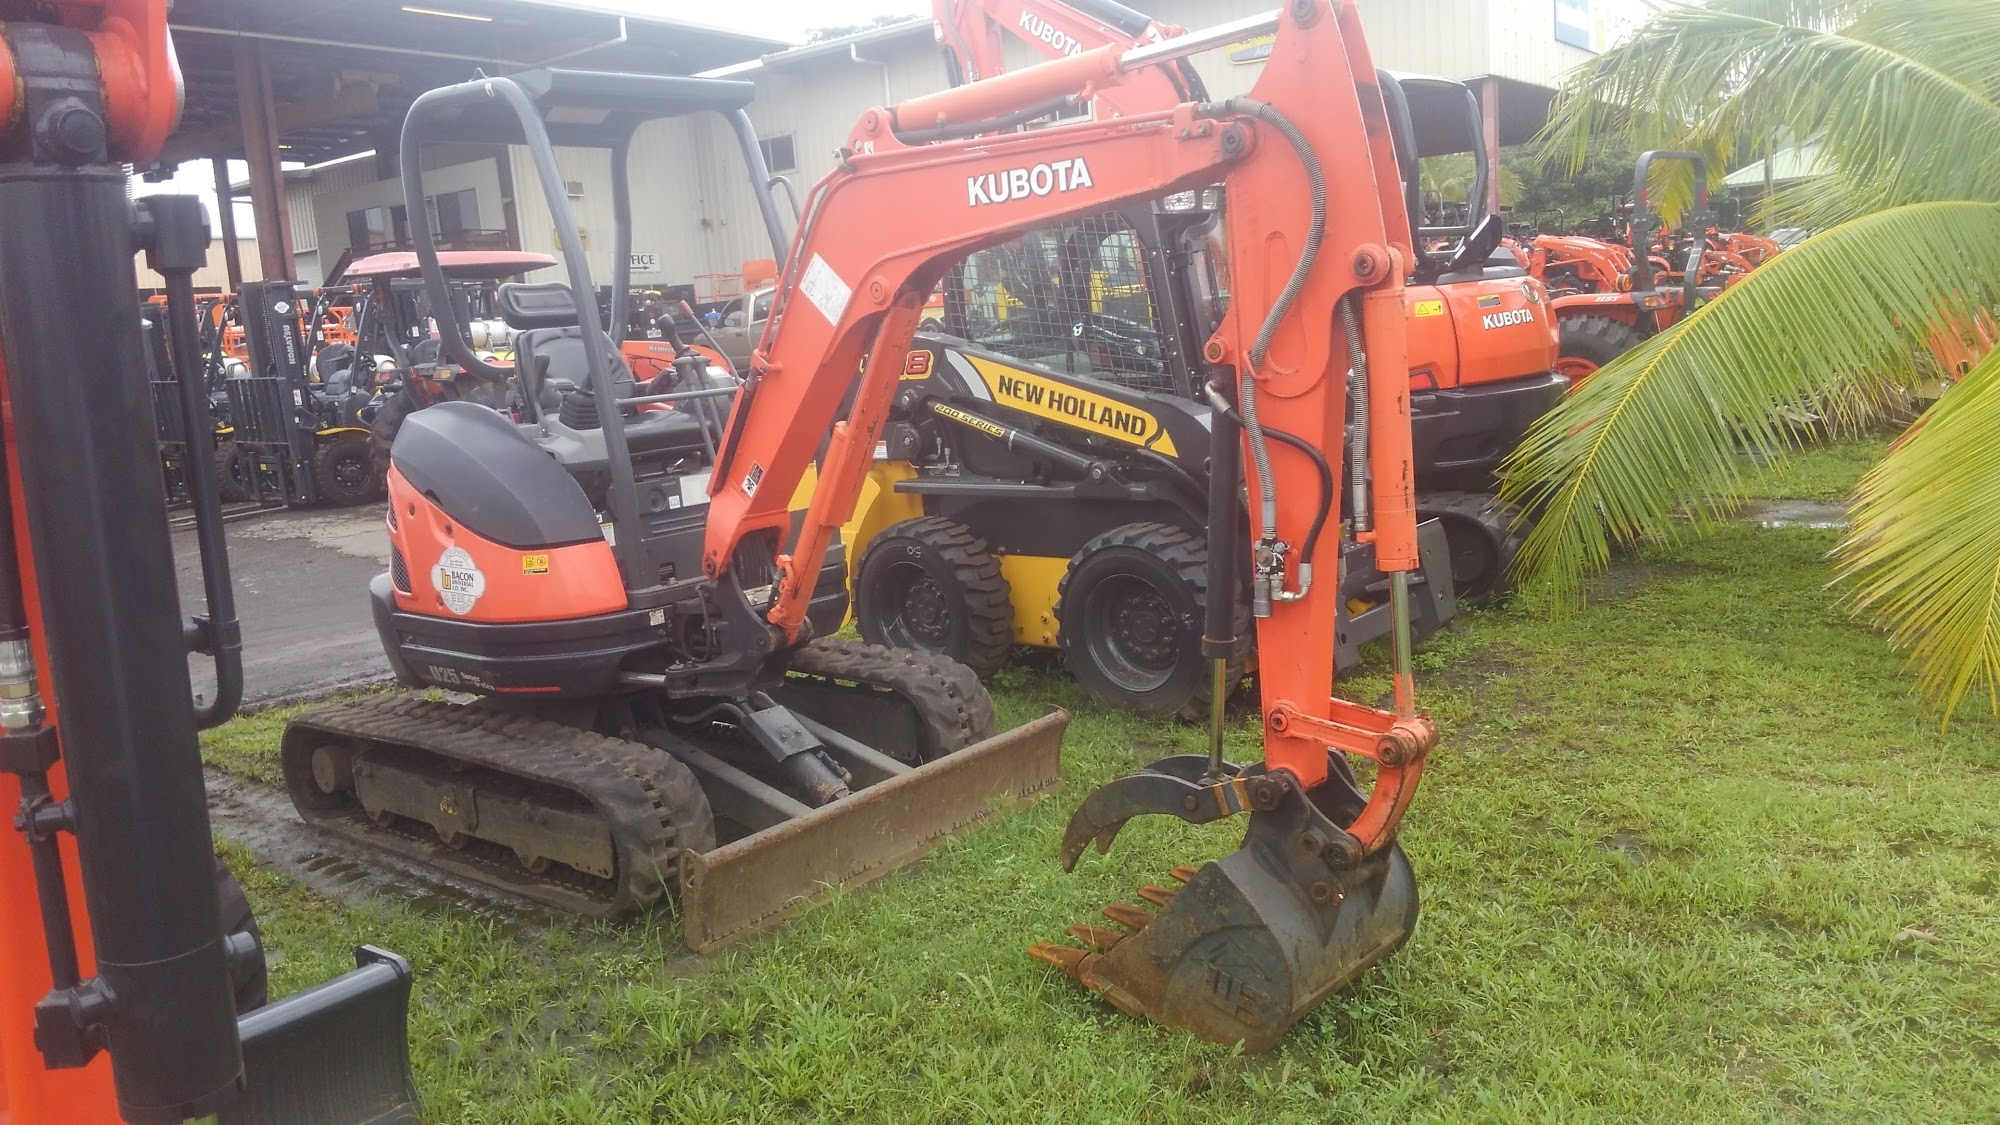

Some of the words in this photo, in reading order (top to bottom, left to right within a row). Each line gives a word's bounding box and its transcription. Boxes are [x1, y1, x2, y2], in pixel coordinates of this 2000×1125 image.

[1018, 9, 1082, 57] KUBOTA
[967, 157, 1093, 206] KUBOTA
[631, 254, 655, 265] FICE
[1482, 308, 1534, 330] KUBOTA
[283, 324, 296, 365] KOMATSU
[935, 404, 960, 418] 200
[960, 414, 1004, 436] SERIES
[998, 375, 1045, 405] NEW
[1048, 390, 1147, 437] HOLLAND
[451, 570, 474, 582] BACON
[428, 664, 461, 684] U25
